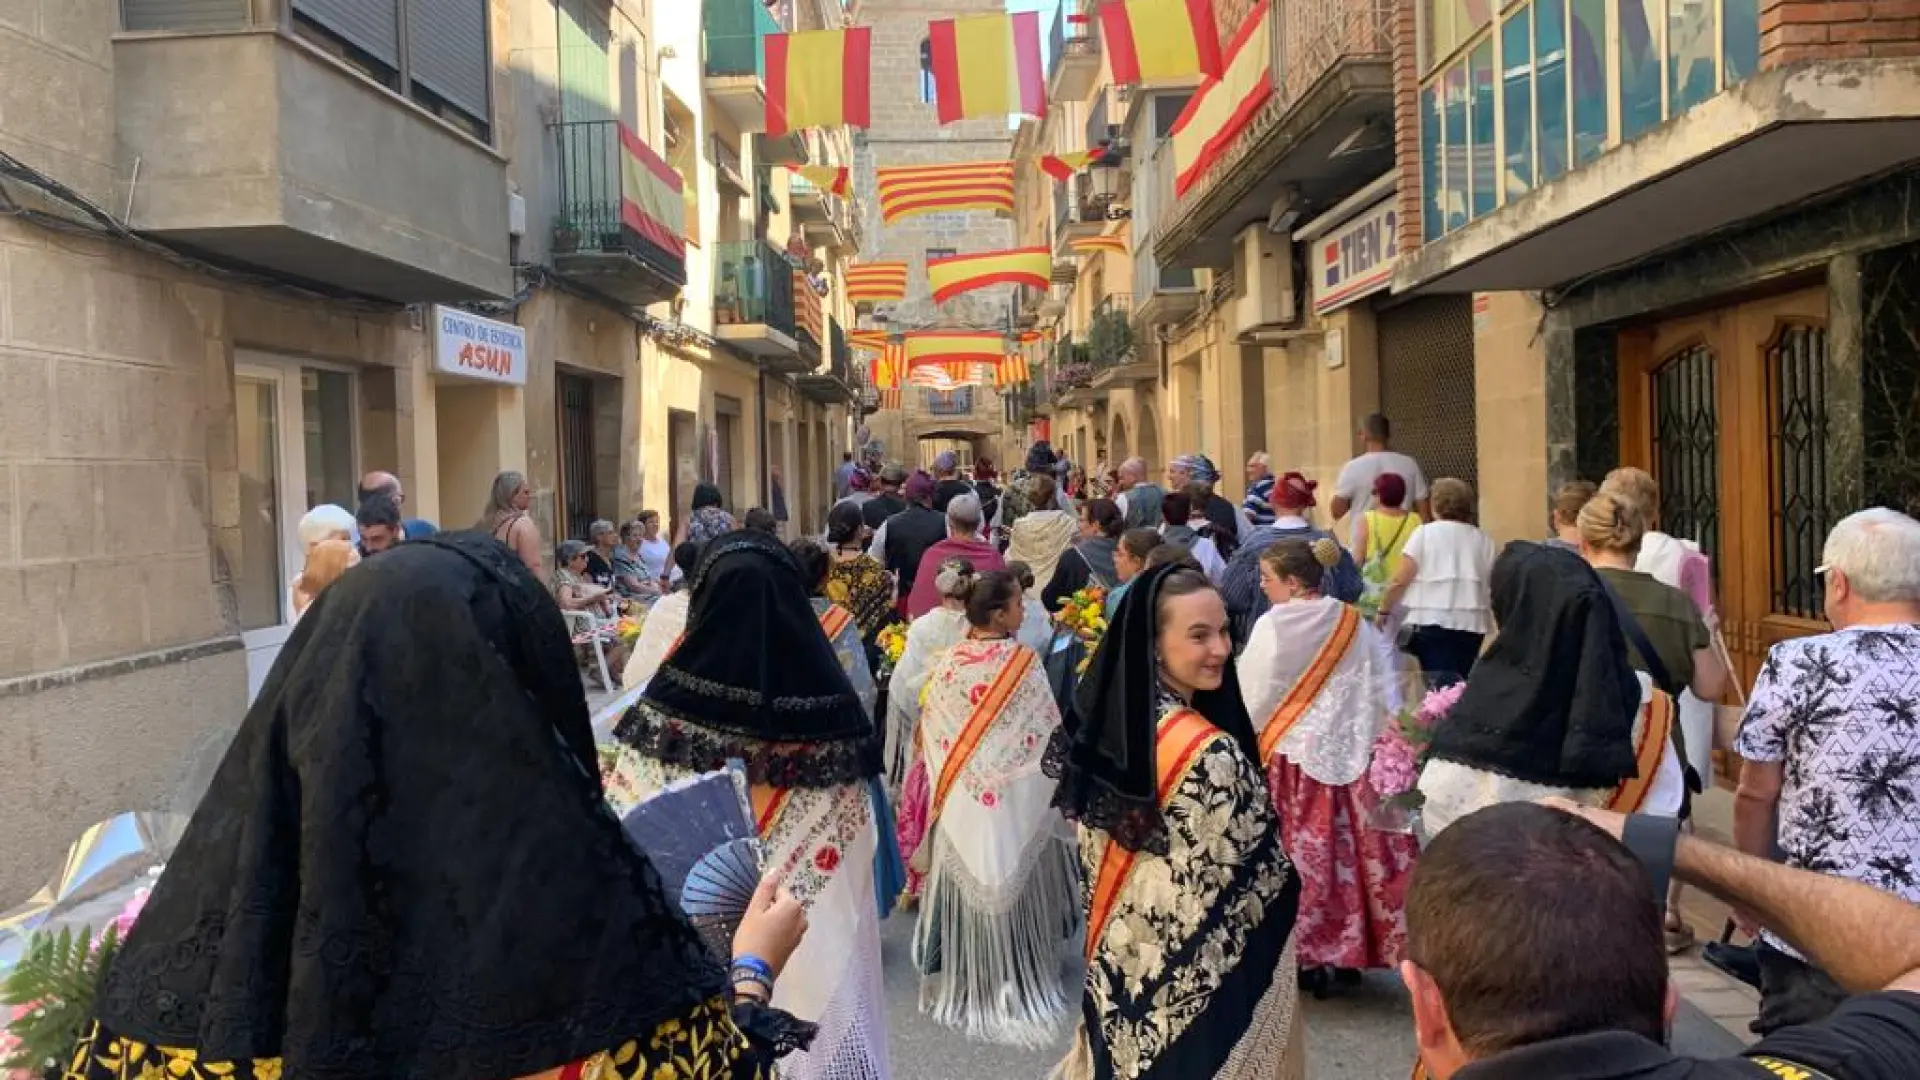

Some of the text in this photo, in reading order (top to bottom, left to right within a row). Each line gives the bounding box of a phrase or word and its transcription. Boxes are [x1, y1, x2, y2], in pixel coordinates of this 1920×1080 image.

[1342, 217, 1380, 279] TIEN
[443, 316, 475, 340] CENTRO
[478, 324, 489, 342] DE
[459, 343, 511, 375] ASUN
